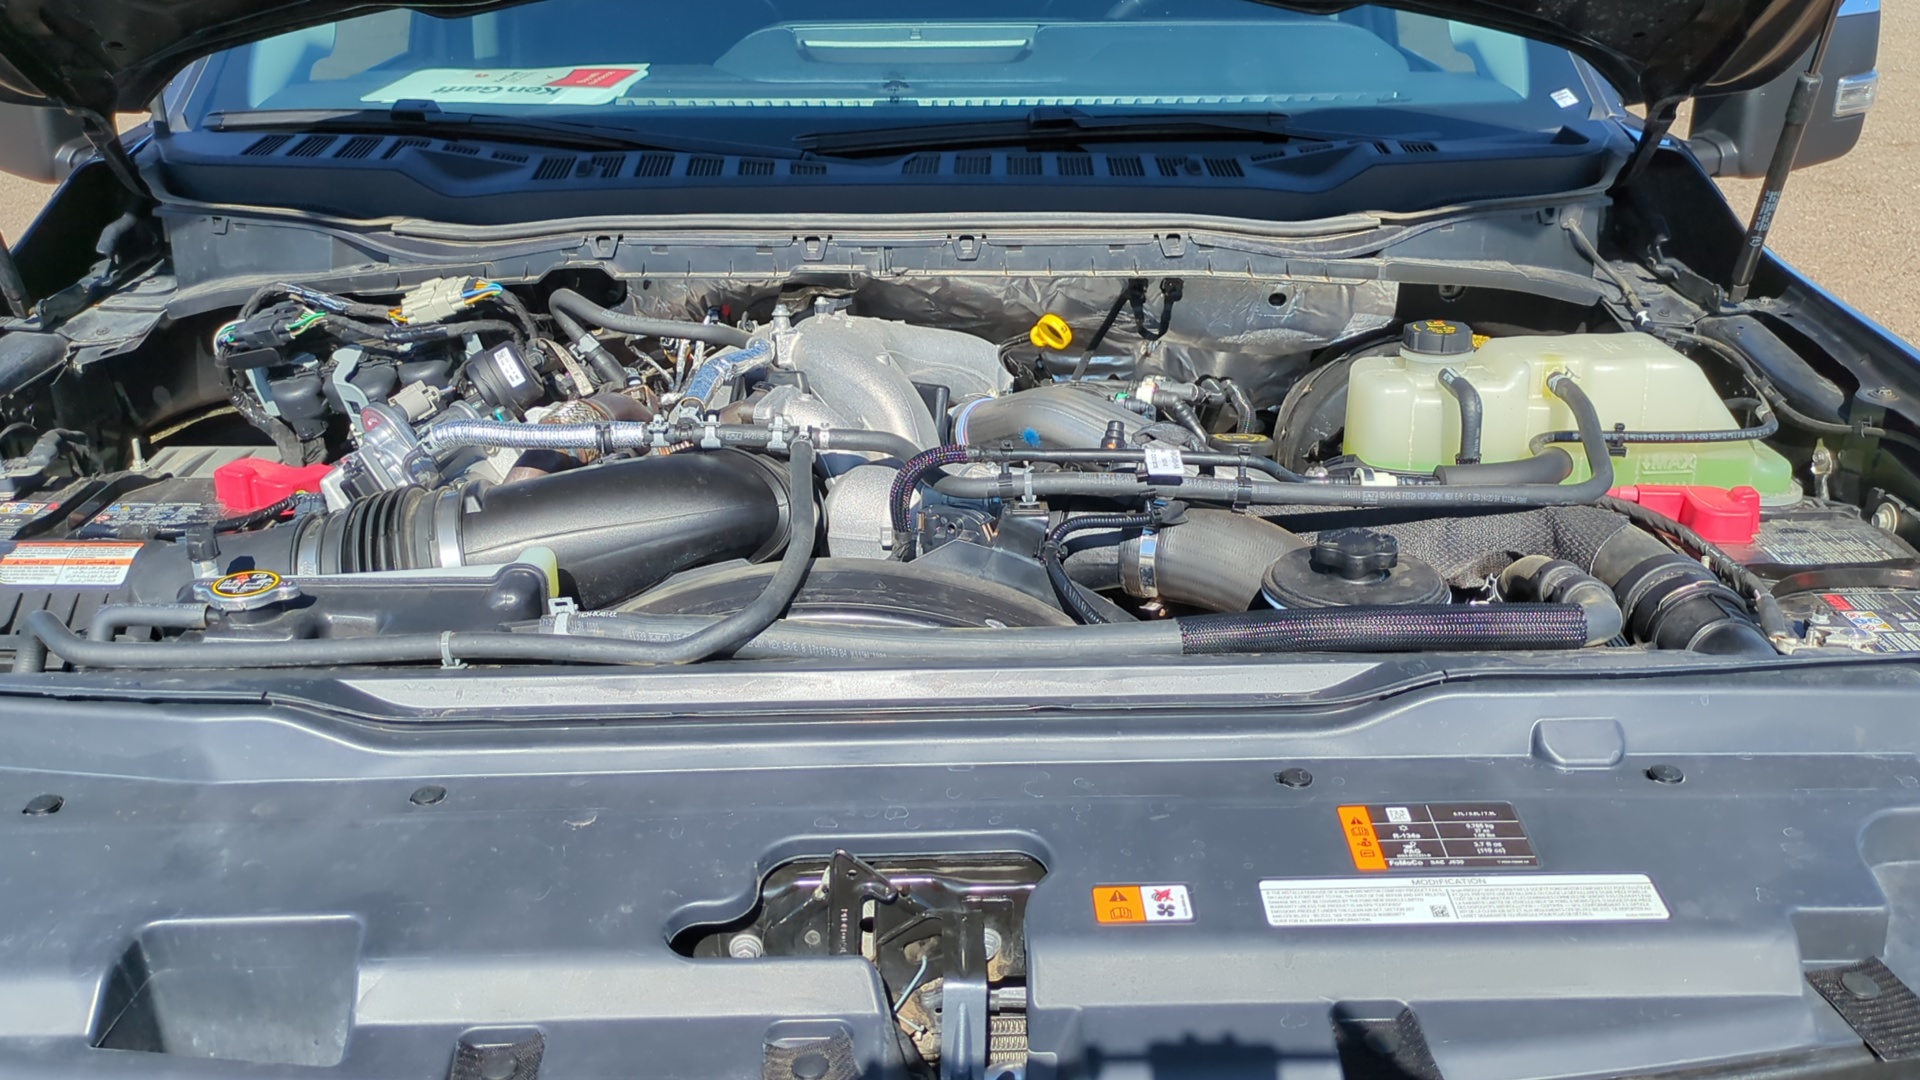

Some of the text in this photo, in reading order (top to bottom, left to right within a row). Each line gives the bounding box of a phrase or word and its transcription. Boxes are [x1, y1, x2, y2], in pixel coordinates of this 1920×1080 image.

[506, 86, 563, 95] Ken
[1651, 453, 1696, 470] MAX
[1410, 877, 1487, 886] MODIFICATION
